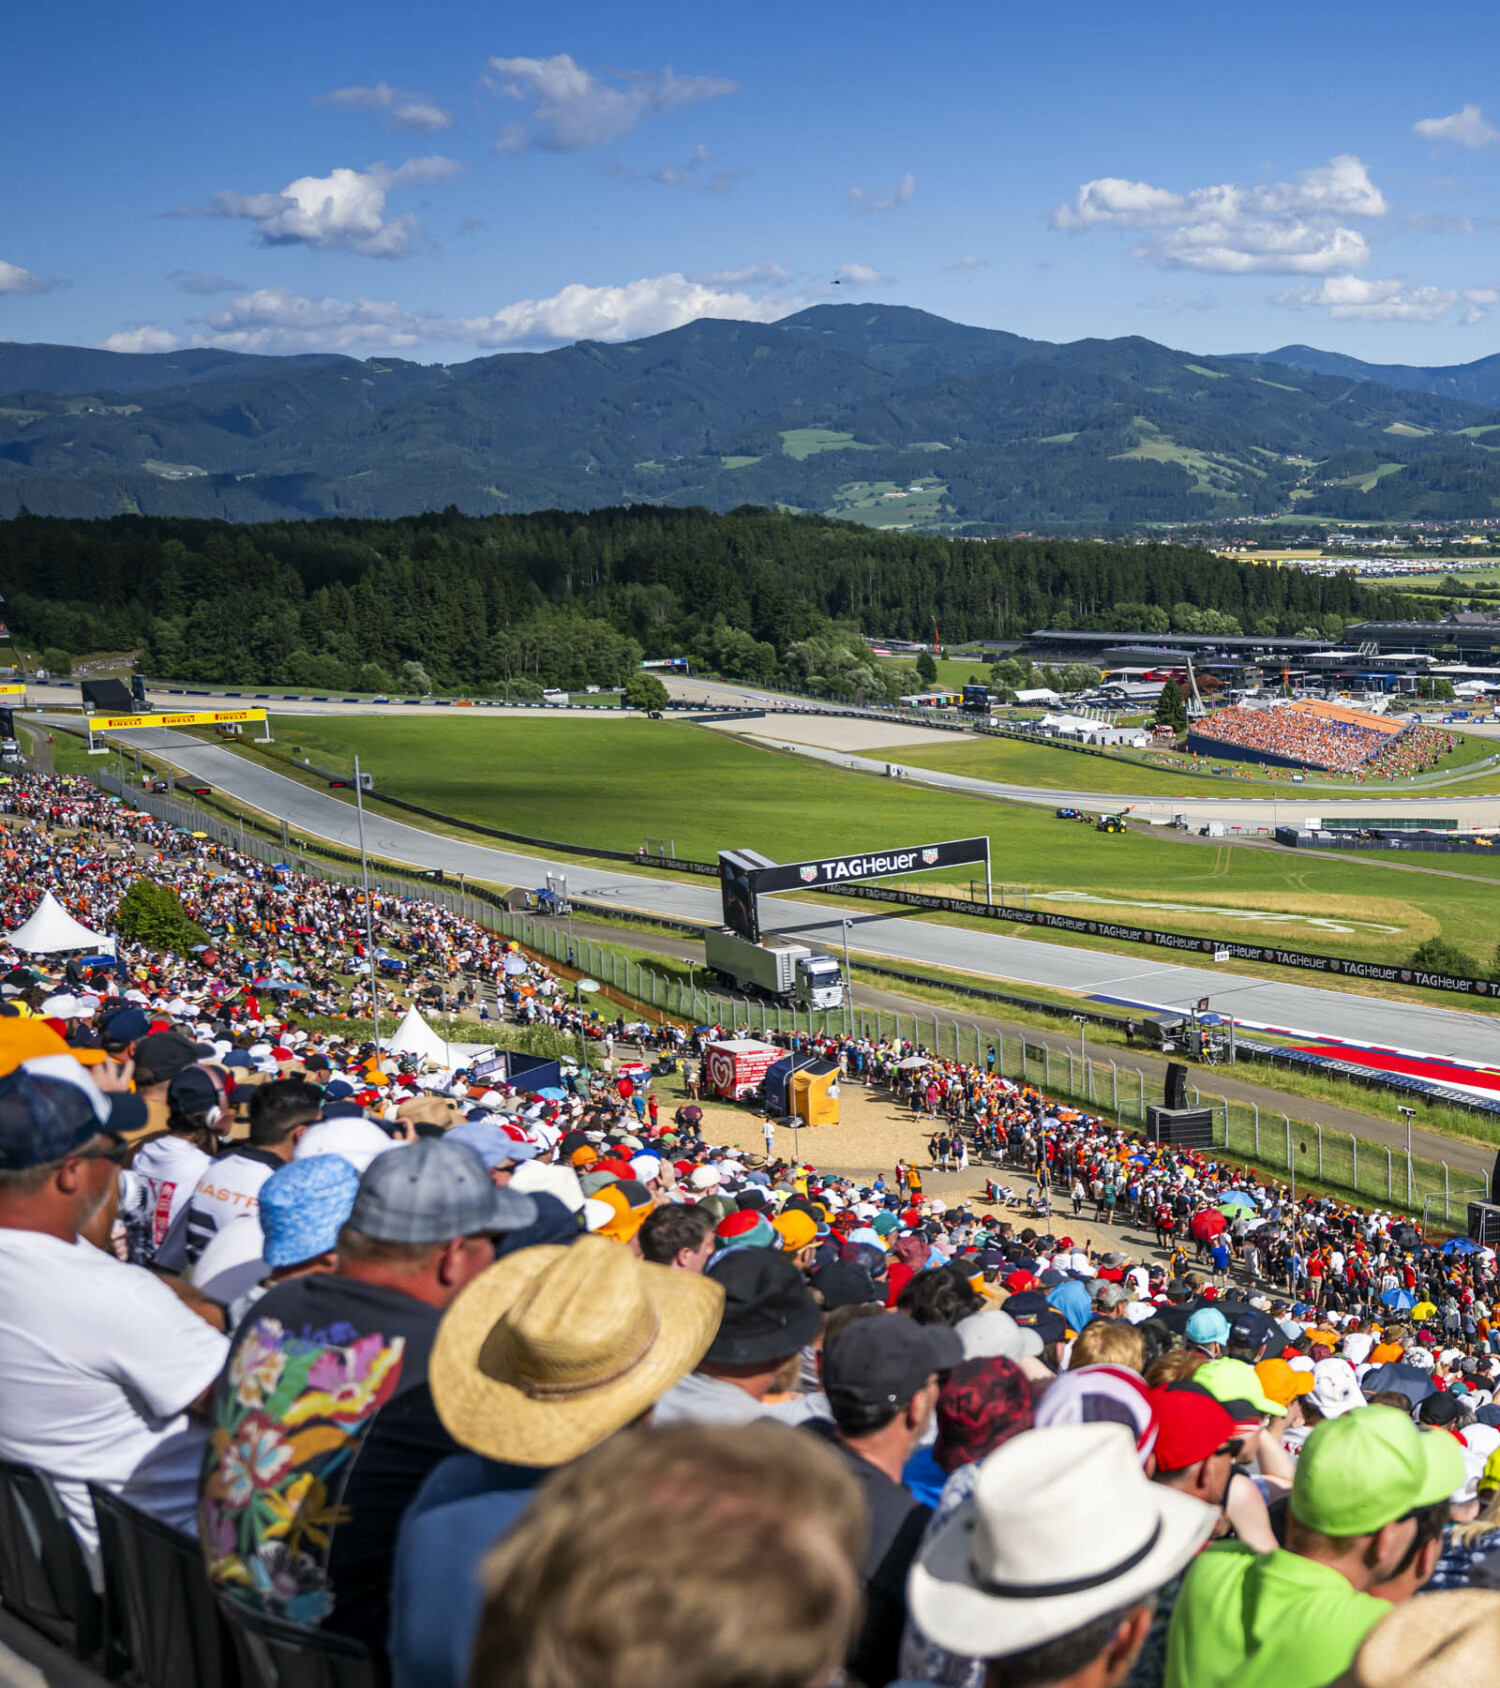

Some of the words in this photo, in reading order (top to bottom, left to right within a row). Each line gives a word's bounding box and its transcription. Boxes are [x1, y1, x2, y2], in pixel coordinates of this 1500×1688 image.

[108, 718, 142, 727] PIRELLI
[162, 715, 195, 724] PIRELLI
[215, 712, 247, 721] PIRELLI
[822, 853, 918, 880] TAGHeuer
[1276, 951, 1328, 969] TAGHeuer
[1342, 961, 1398, 980] TAGHeuer
[1414, 972, 1472, 991] TAGHeuer
[197, 1180, 259, 1208] IASTR
